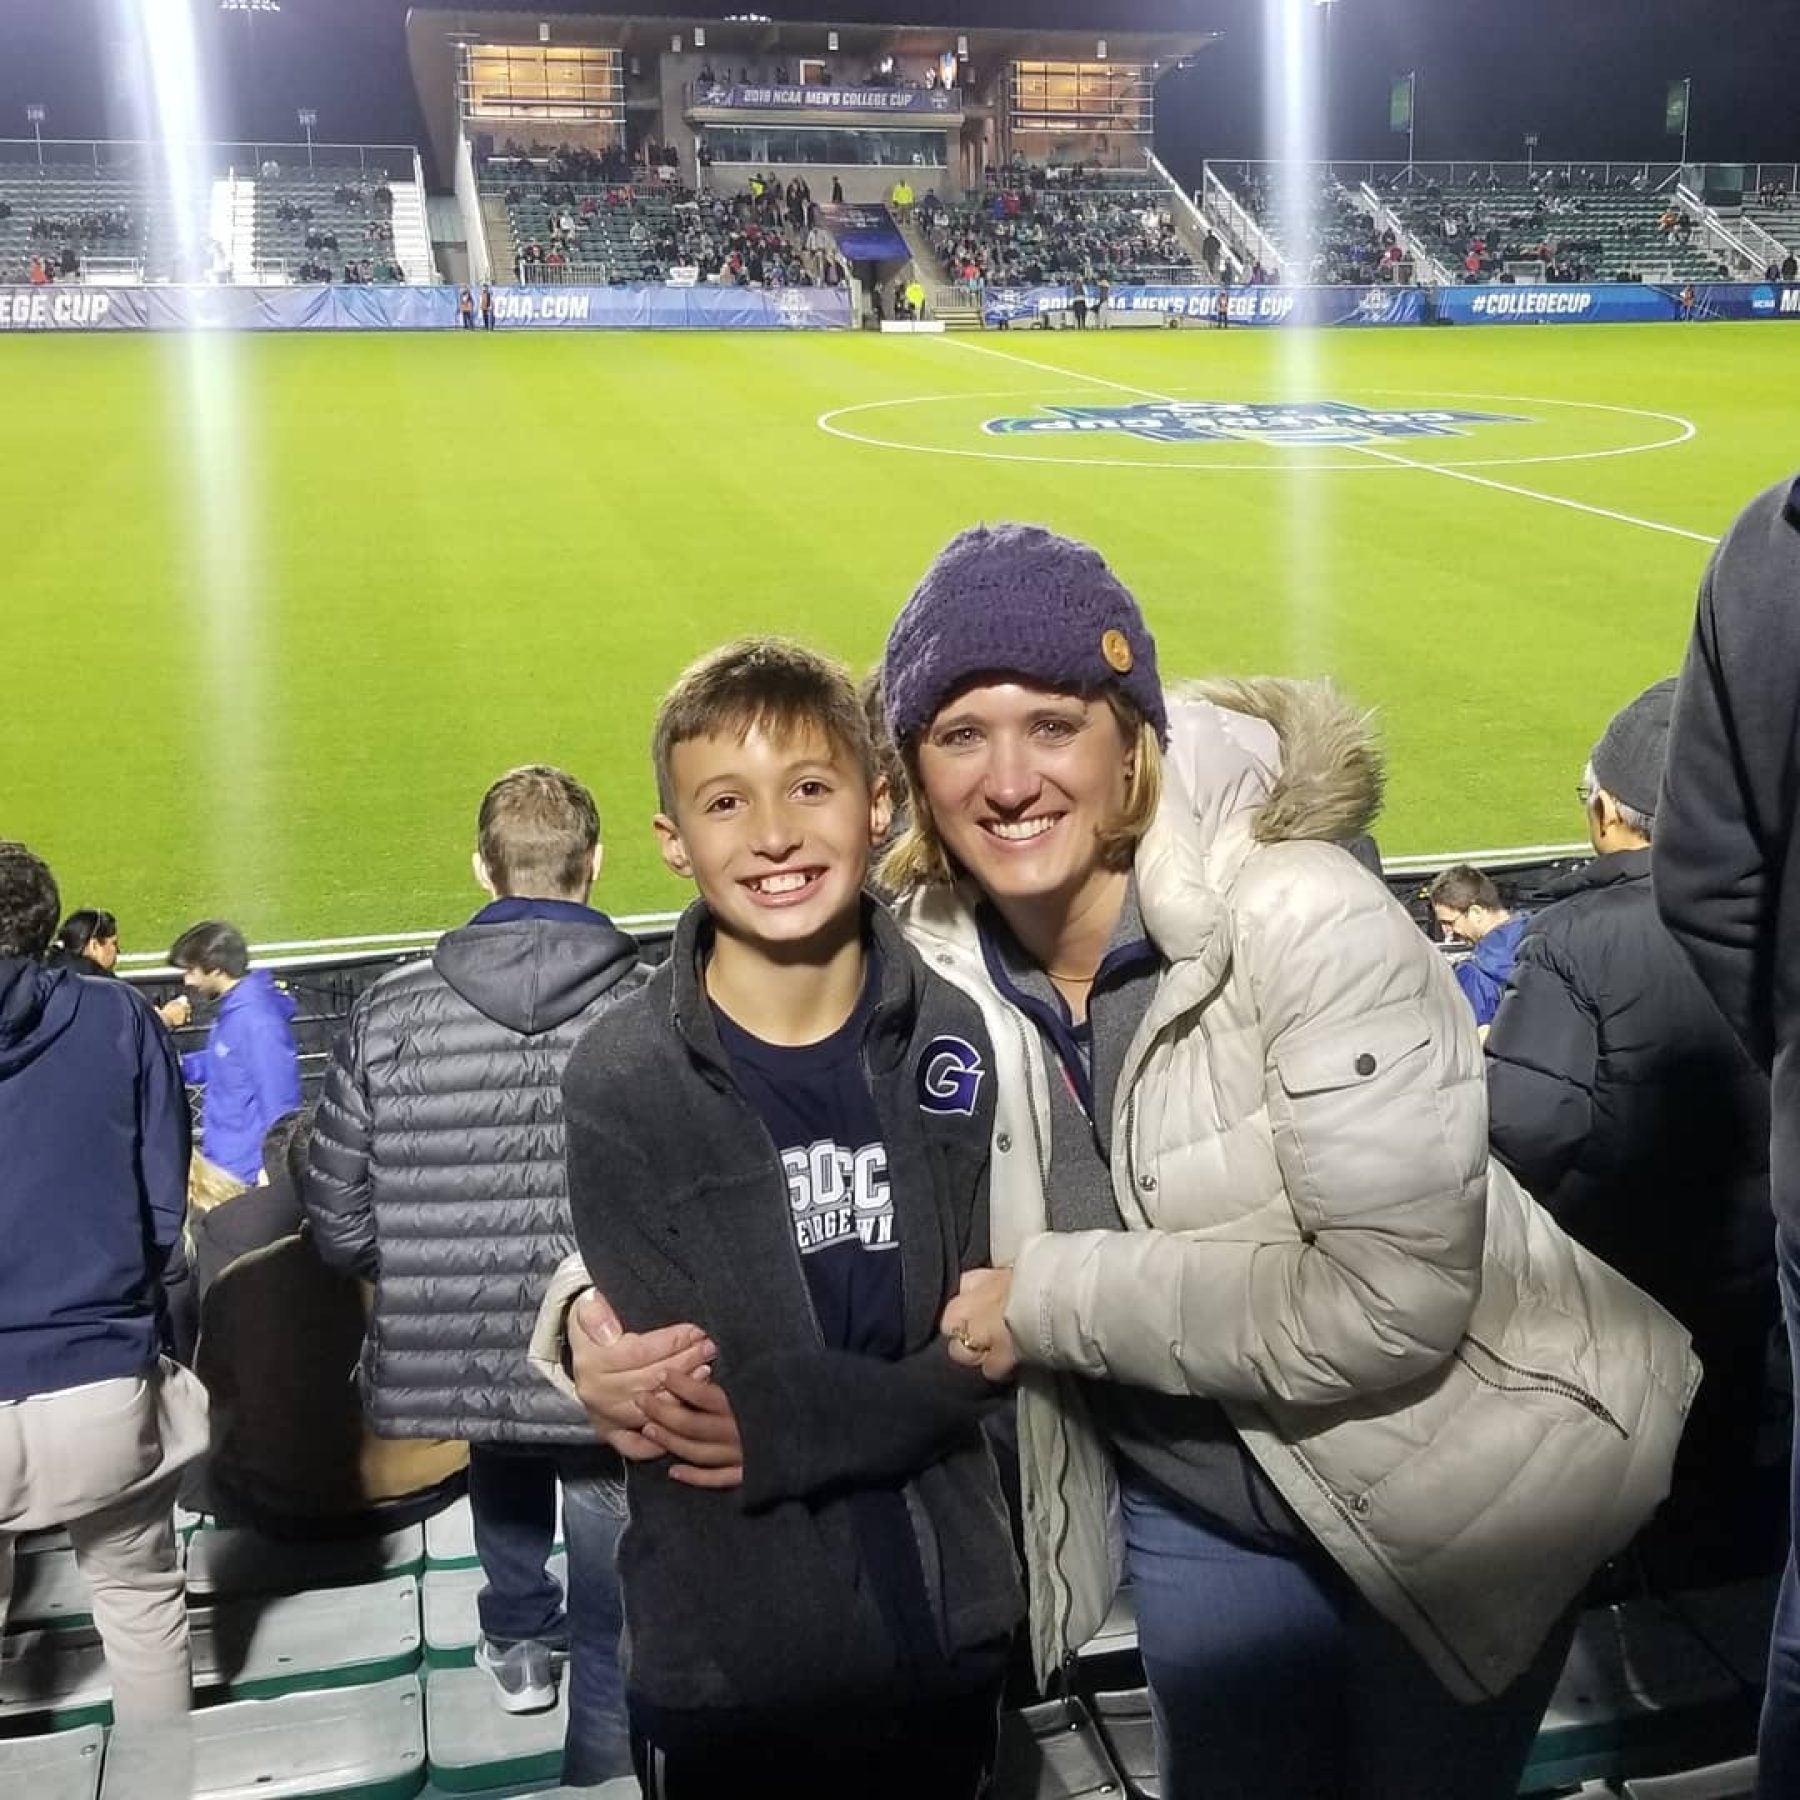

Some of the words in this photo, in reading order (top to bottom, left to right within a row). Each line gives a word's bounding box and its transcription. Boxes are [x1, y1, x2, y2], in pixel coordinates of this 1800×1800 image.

[805, 91, 840, 106] MEN'S
[842, 92, 889, 106] COLLEGE
[890, 94, 913, 107] CUP
[53, 294, 110, 322] CUP
[480, 294, 590, 319] CAA.COM
[1189, 296, 1257, 316] COLEGE
[1259, 297, 1294, 317] CUP
[1472, 293, 1591, 314] #COLLEGECUP
[916, 1034, 985, 1116] G
